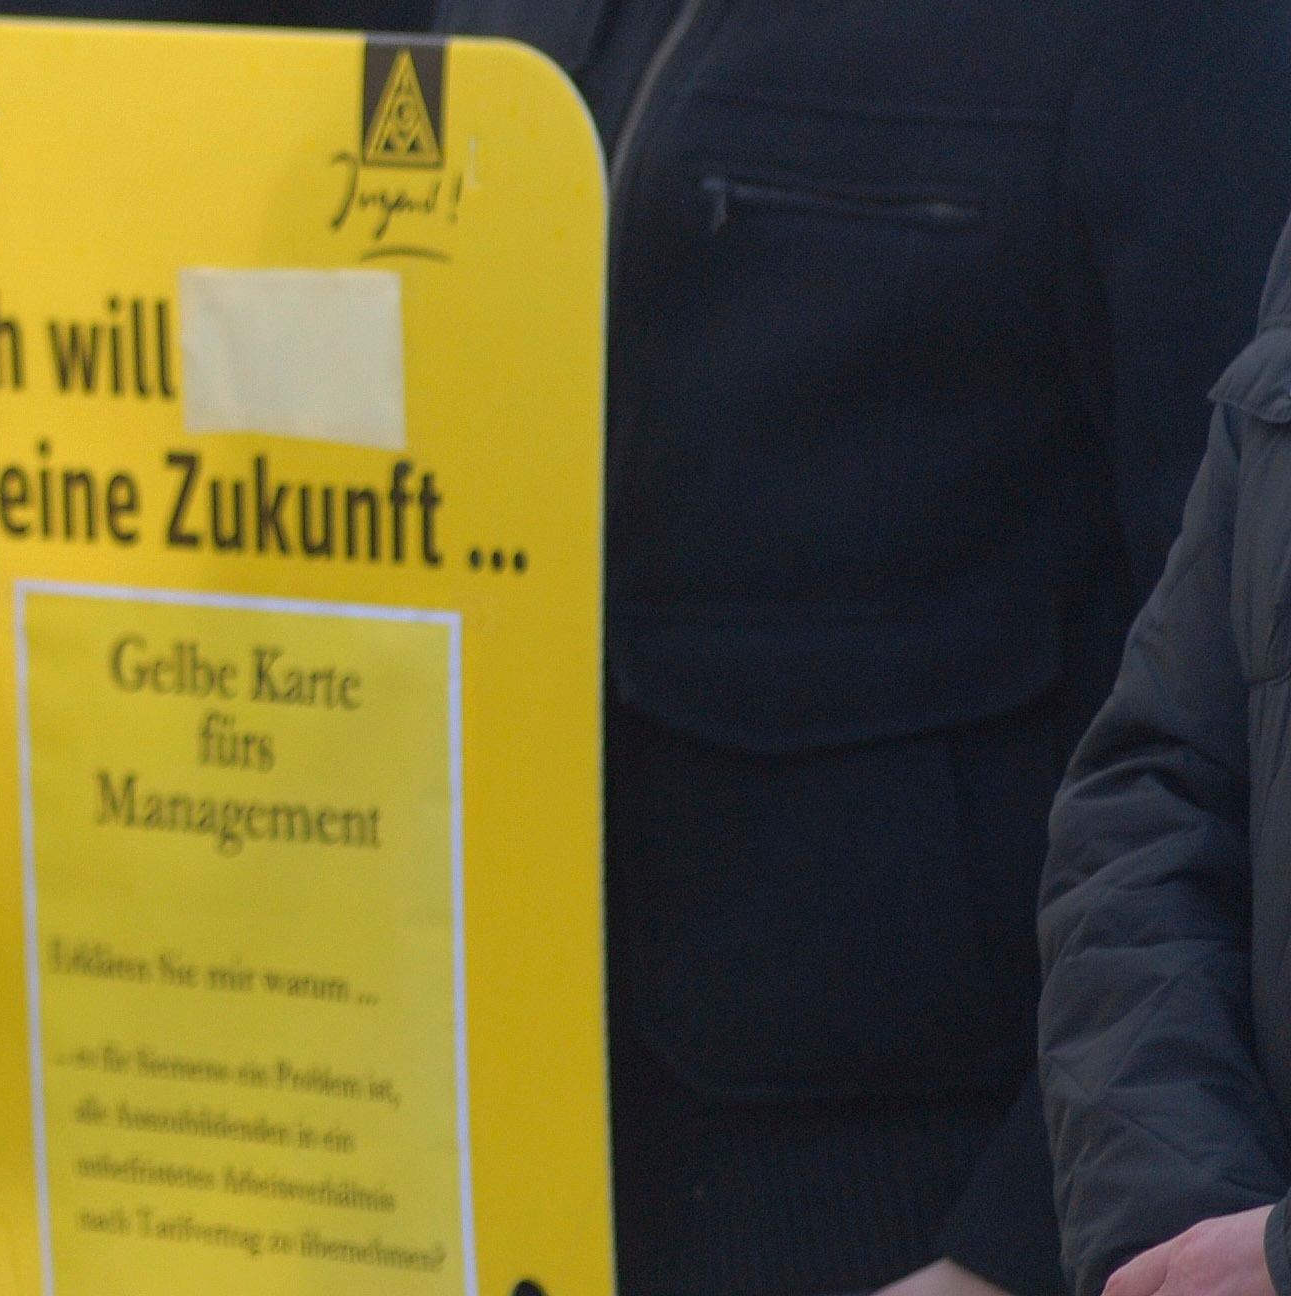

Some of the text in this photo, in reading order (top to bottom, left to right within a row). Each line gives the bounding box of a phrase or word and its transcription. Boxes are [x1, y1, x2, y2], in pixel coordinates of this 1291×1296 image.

[46, 294, 176, 400] will
[164, 450, 443, 568] Zukunft
[109, 632, 363, 710] Gelbe Karte
[198, 709, 276, 773] fürs
[94, 770, 382, 858] Management
[263, 967, 351, 1003] warum
